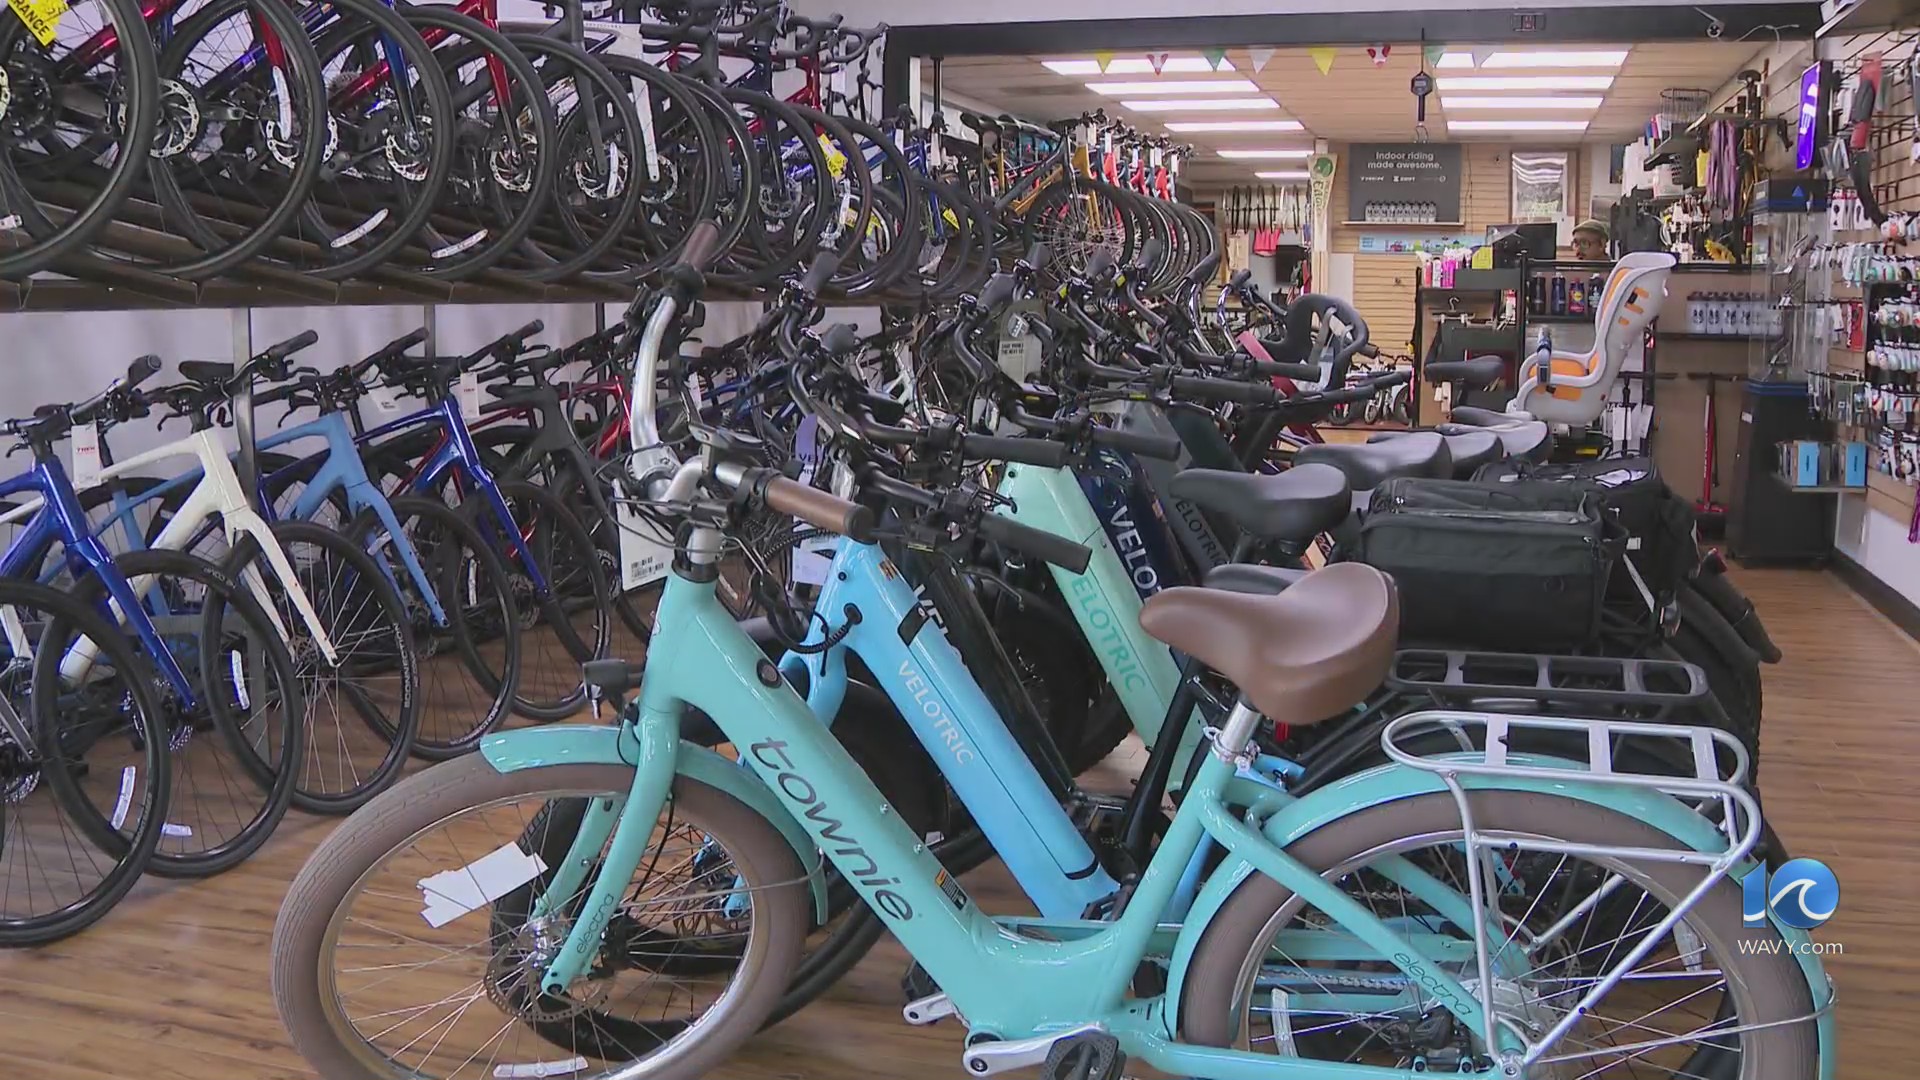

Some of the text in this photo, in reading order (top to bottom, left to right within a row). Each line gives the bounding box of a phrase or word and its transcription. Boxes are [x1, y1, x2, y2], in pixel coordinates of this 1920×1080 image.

[1367, 161, 1442, 169] made awesome.
[1375, 151, 1434, 161] Indoor riding
[1110, 504, 1162, 593] VELO
[898, 660, 974, 765] VELOTRIC
[750, 736, 913, 921] townie
[577, 893, 614, 954] electra
[1394, 952, 1472, 1015] electra
